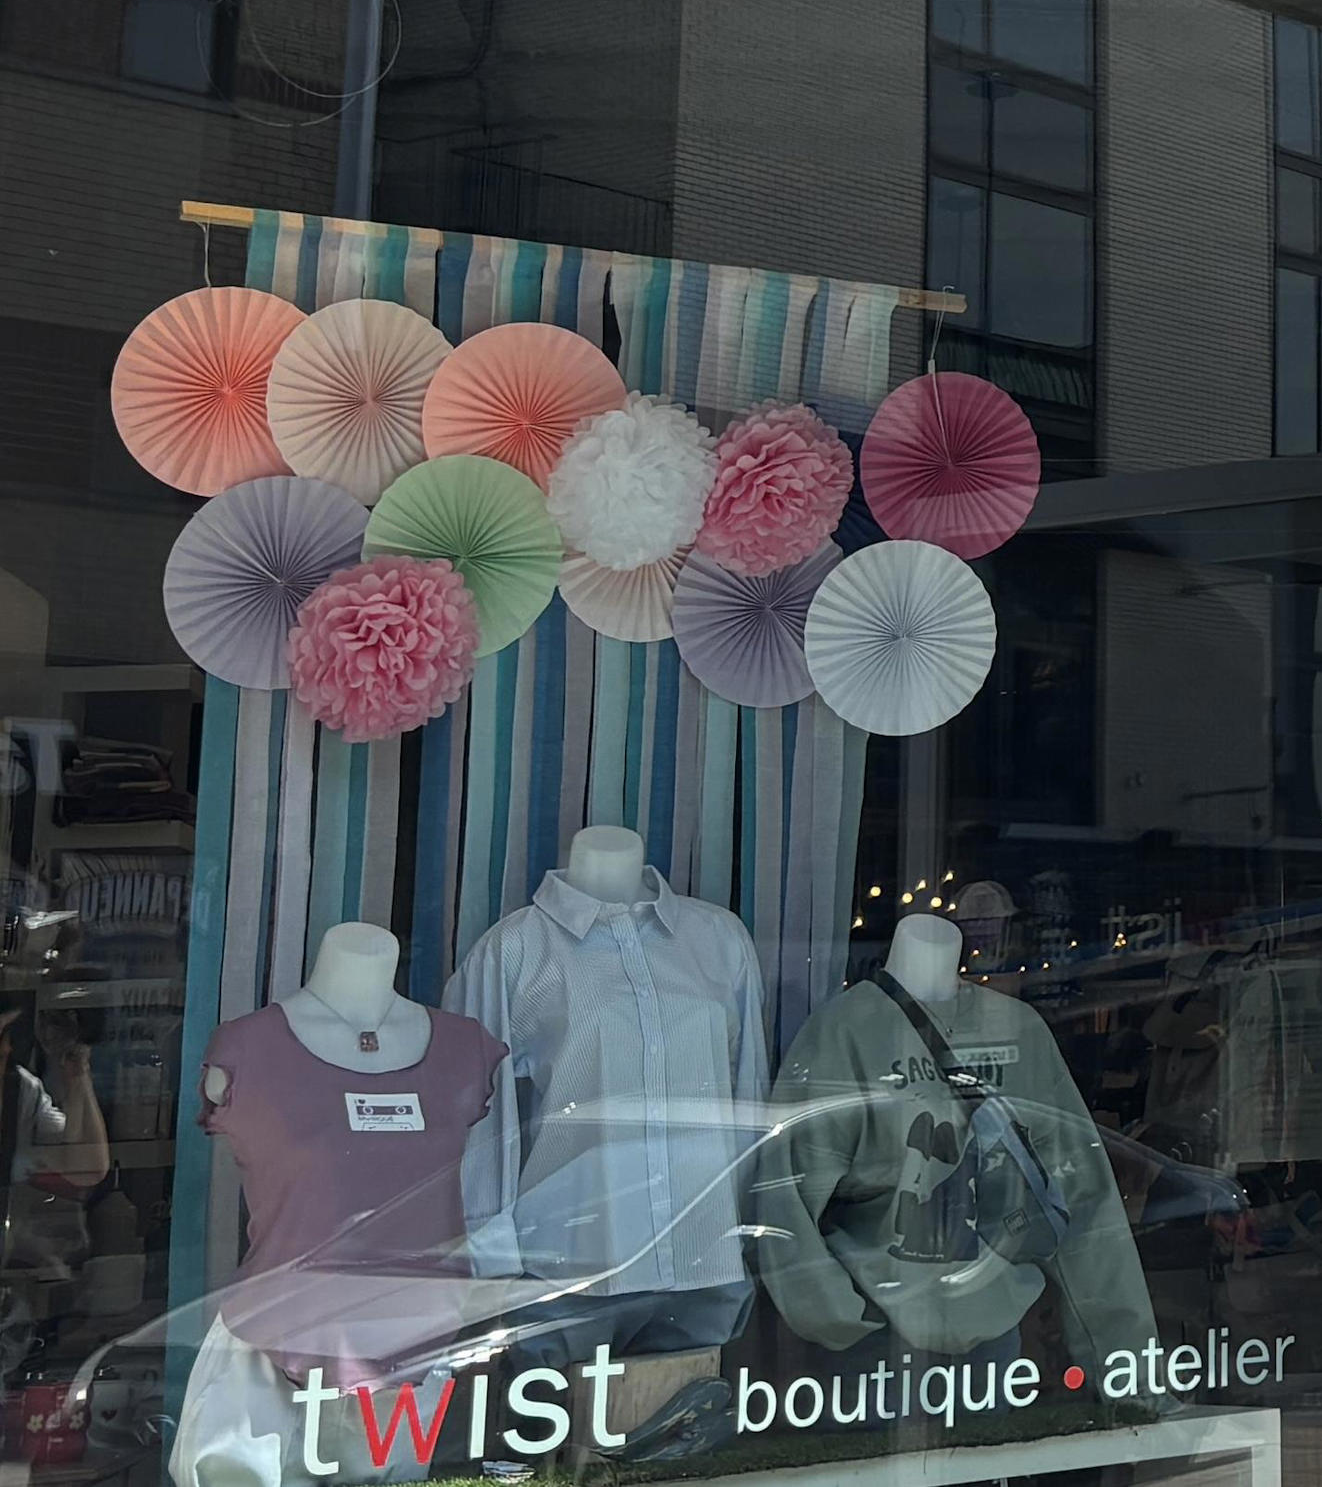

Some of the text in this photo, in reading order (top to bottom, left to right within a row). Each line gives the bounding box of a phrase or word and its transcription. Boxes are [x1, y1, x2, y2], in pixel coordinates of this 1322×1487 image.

[293, 1343, 629, 1476] twist
[736, 1351, 1041, 1436] boutique
[1102, 1327, 1297, 1400] atelier
